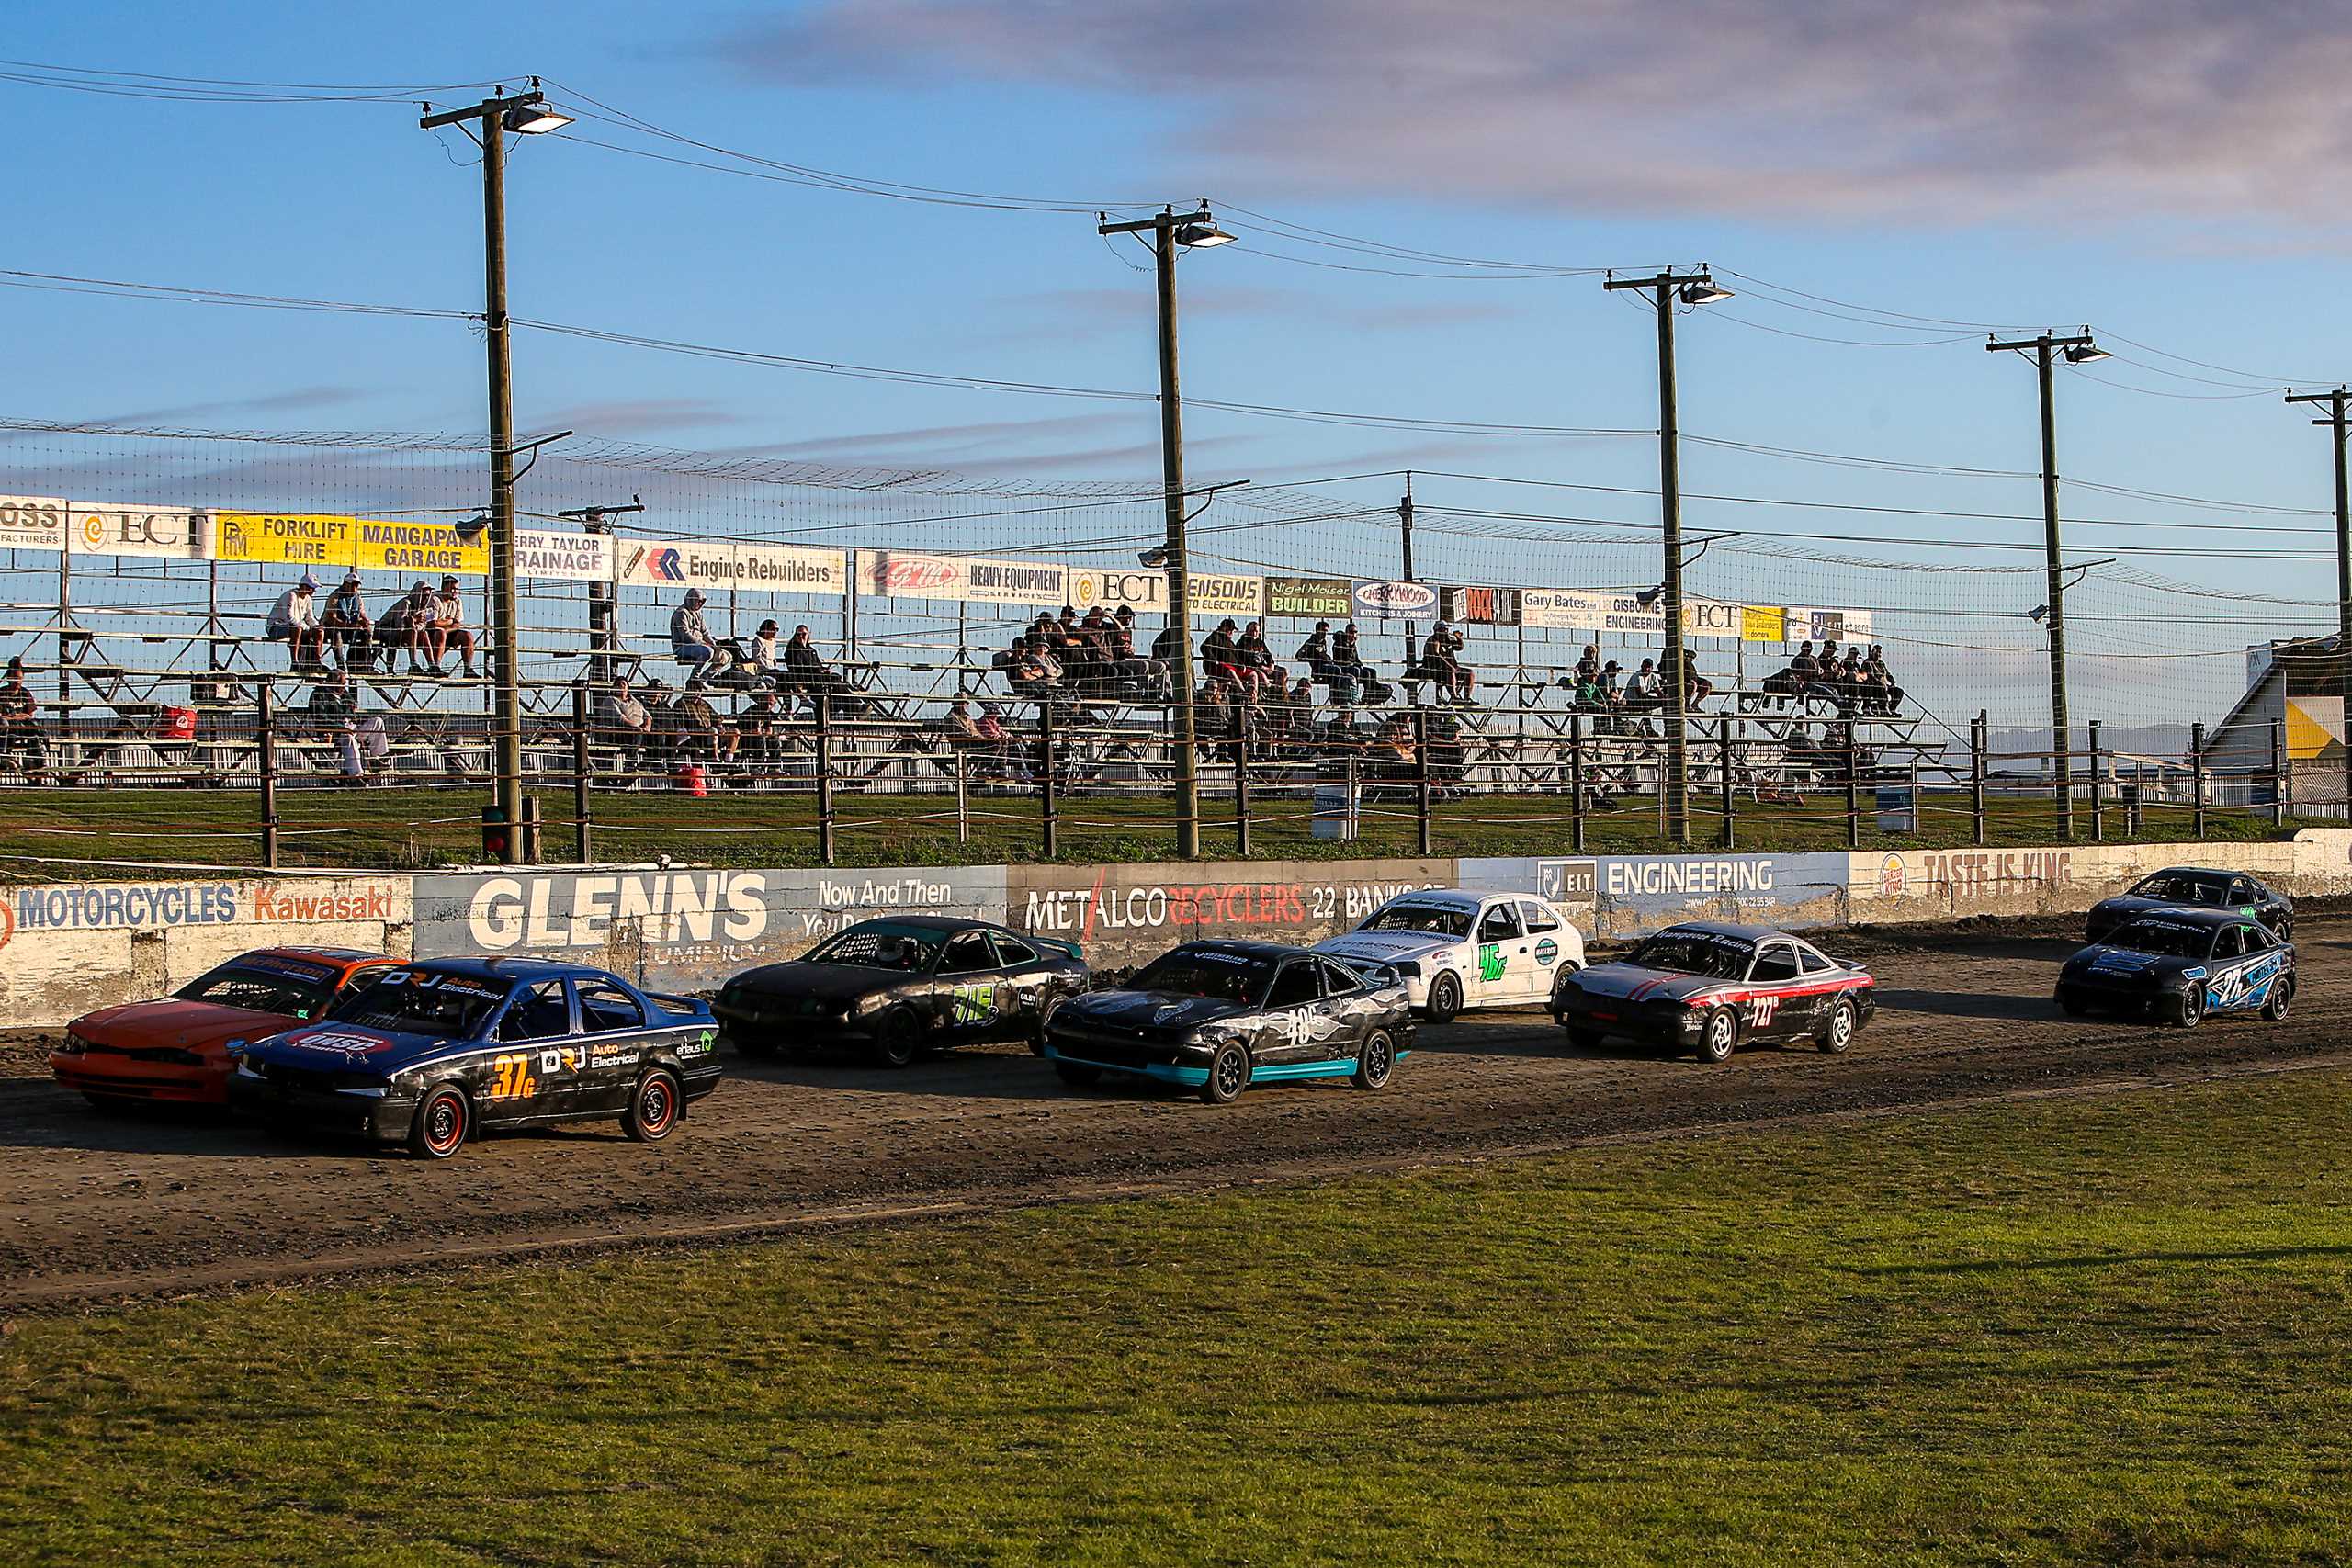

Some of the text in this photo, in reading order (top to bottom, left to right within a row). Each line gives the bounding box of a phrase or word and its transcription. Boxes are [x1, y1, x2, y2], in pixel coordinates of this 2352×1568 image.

[117, 514, 209, 546] ECT
[264, 518, 348, 540] FORKLIFT
[363, 525, 487, 548] MANGAPA
[285, 541, 326, 560] HIRE
[553, 537, 600, 551] TAYLOR
[384, 548, 461, 569] GARAGE
[690, 556, 744, 582] Engine
[748, 558, 830, 582] Rebuilders
[970, 565, 1002, 587] HEAVY
[1004, 568, 1062, 592] EQUIPMENT
[1102, 574, 1163, 603] ECT
[1272, 582, 1306, 595] Nigel
[1202, 599, 1257, 612] ELECTRICAL
[1271, 596, 1348, 614] BUILDER
[1525, 592, 1552, 609] Gary
[1555, 594, 1586, 608] Bates
[1403, 609, 1432, 619] JOINERY
[1696, 604, 1737, 628] ECT
[1566, 874, 1591, 893] EIT
[1608, 860, 1773, 895] ENGINEERING
[1924, 852, 2072, 898] TASTE IS KING
[818, 879, 951, 906] Now And Then
[19, 885, 393, 927] MOTORCYCLES Kawasaki
[469, 872, 767, 950] GLENN'S
[1167, 884, 1305, 924] RECYCLERS
[1312, 886, 1336, 919] 22
[1710, 934, 1754, 953] Racing
[437, 983, 504, 1000] Electrical
[445, 976, 482, 988] Auto
[592, 1043, 619, 1055] Auto
[591, 1052, 639, 1068] Electrical
